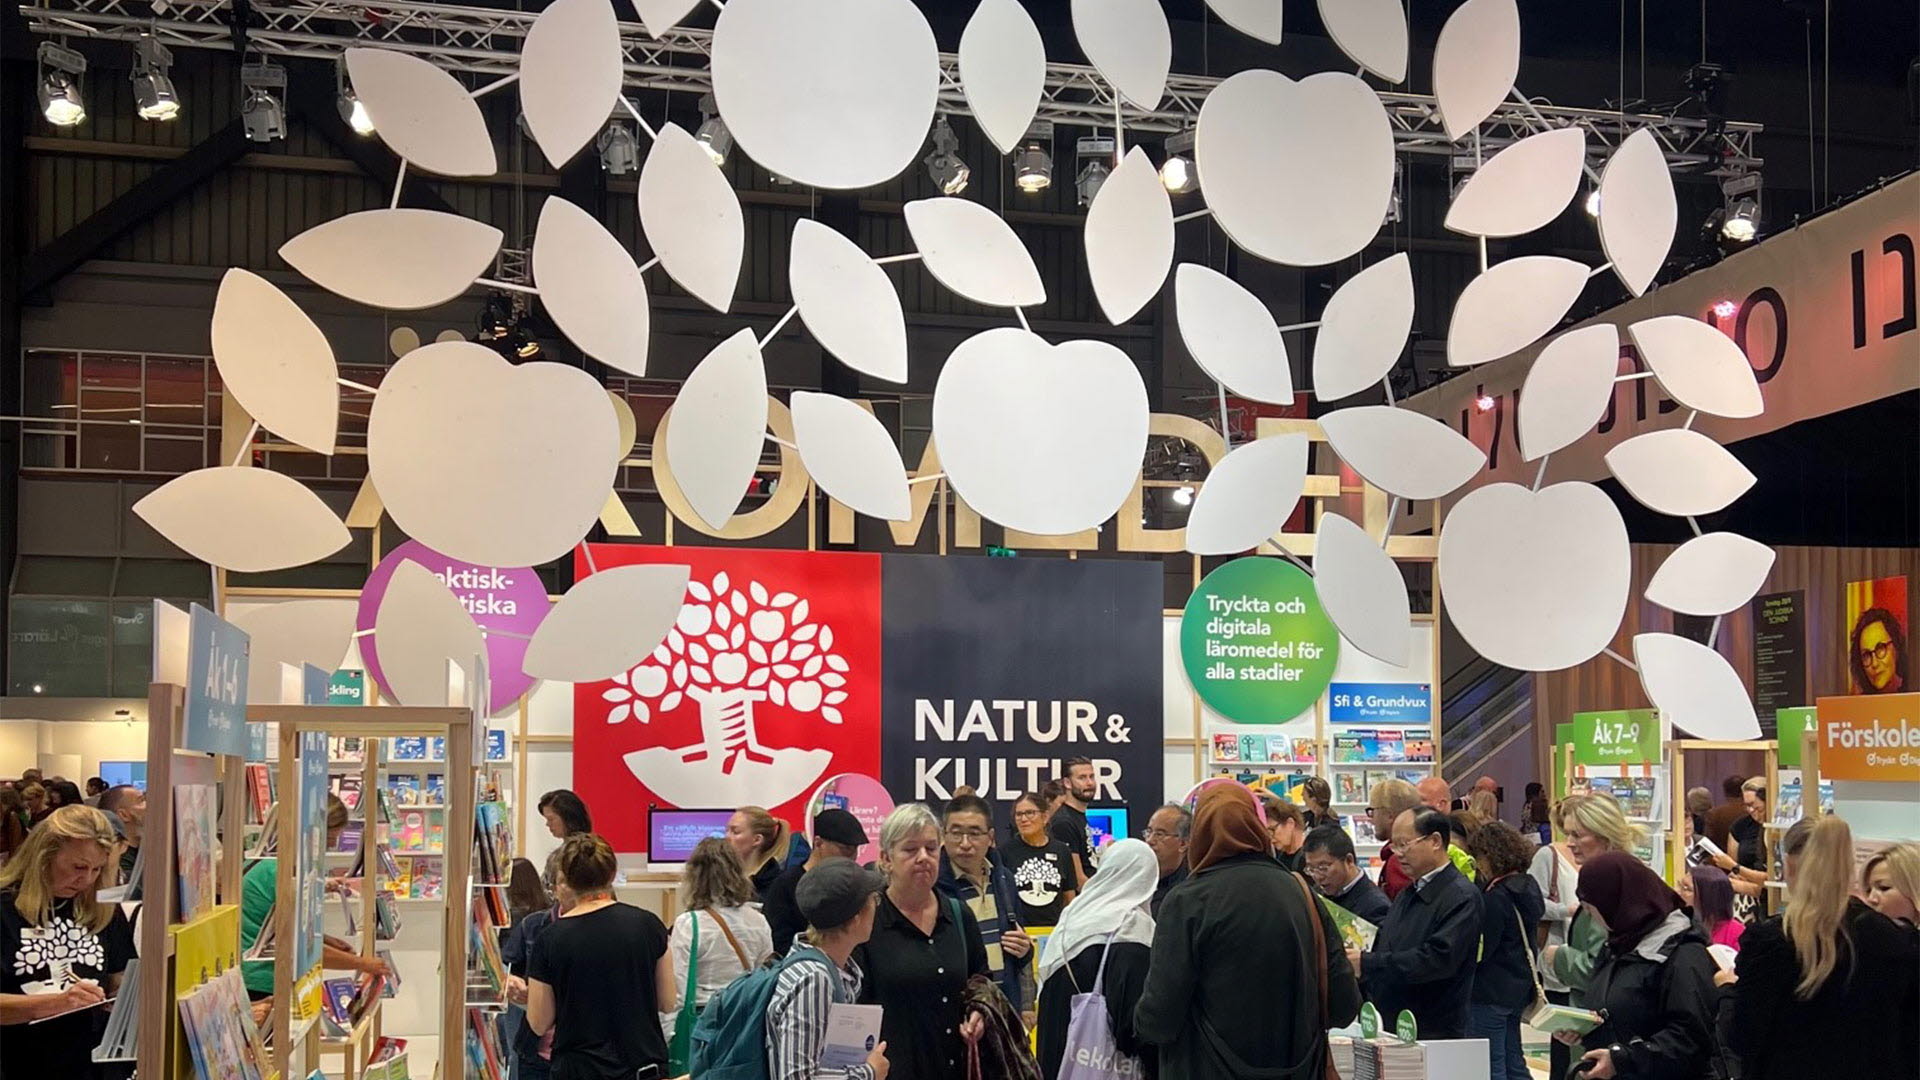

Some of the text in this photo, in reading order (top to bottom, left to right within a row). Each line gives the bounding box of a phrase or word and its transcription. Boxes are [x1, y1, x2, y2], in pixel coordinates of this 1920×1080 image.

[1206, 595, 1306, 616] Tryckta och
[1206, 618, 1271, 639] digitala
[1206, 640, 1324, 660] läromedel för
[1206, 662, 1304, 682] alla stadier
[1334, 695, 1427, 709] Sfi & Grundvux
[915, 699, 1131, 743] NATUR &
[1593, 718, 1612, 744] Åk
[1827, 719, 1920, 749] Förskole
